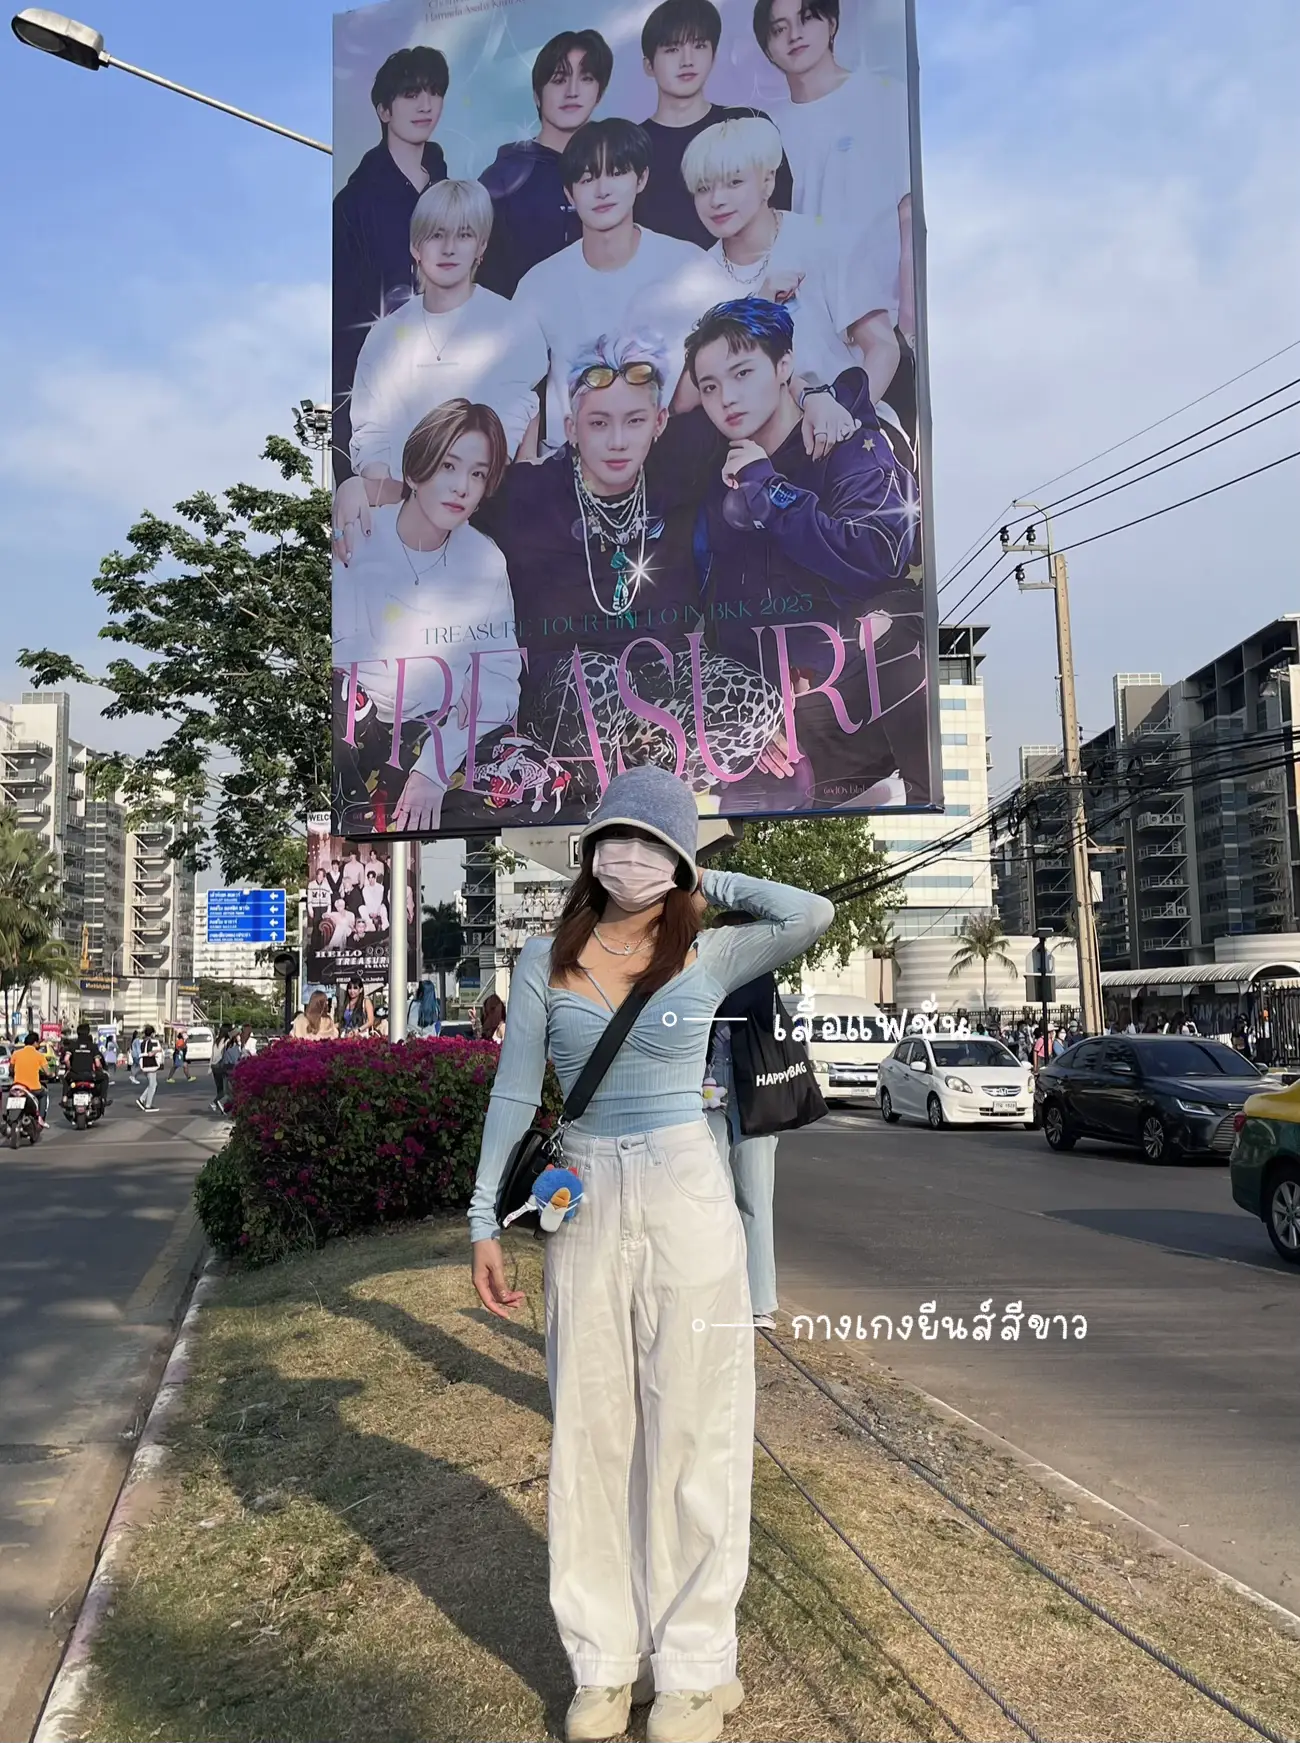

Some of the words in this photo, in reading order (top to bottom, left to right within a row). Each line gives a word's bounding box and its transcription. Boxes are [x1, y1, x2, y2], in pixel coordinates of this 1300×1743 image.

[421, 619, 533, 645] TREASURE
[541, 614, 599, 636] TOUR
[710, 600, 753, 621] BKK
[332, 611, 927, 803] TREASURE
[315, 949, 363, 958] HELLO
